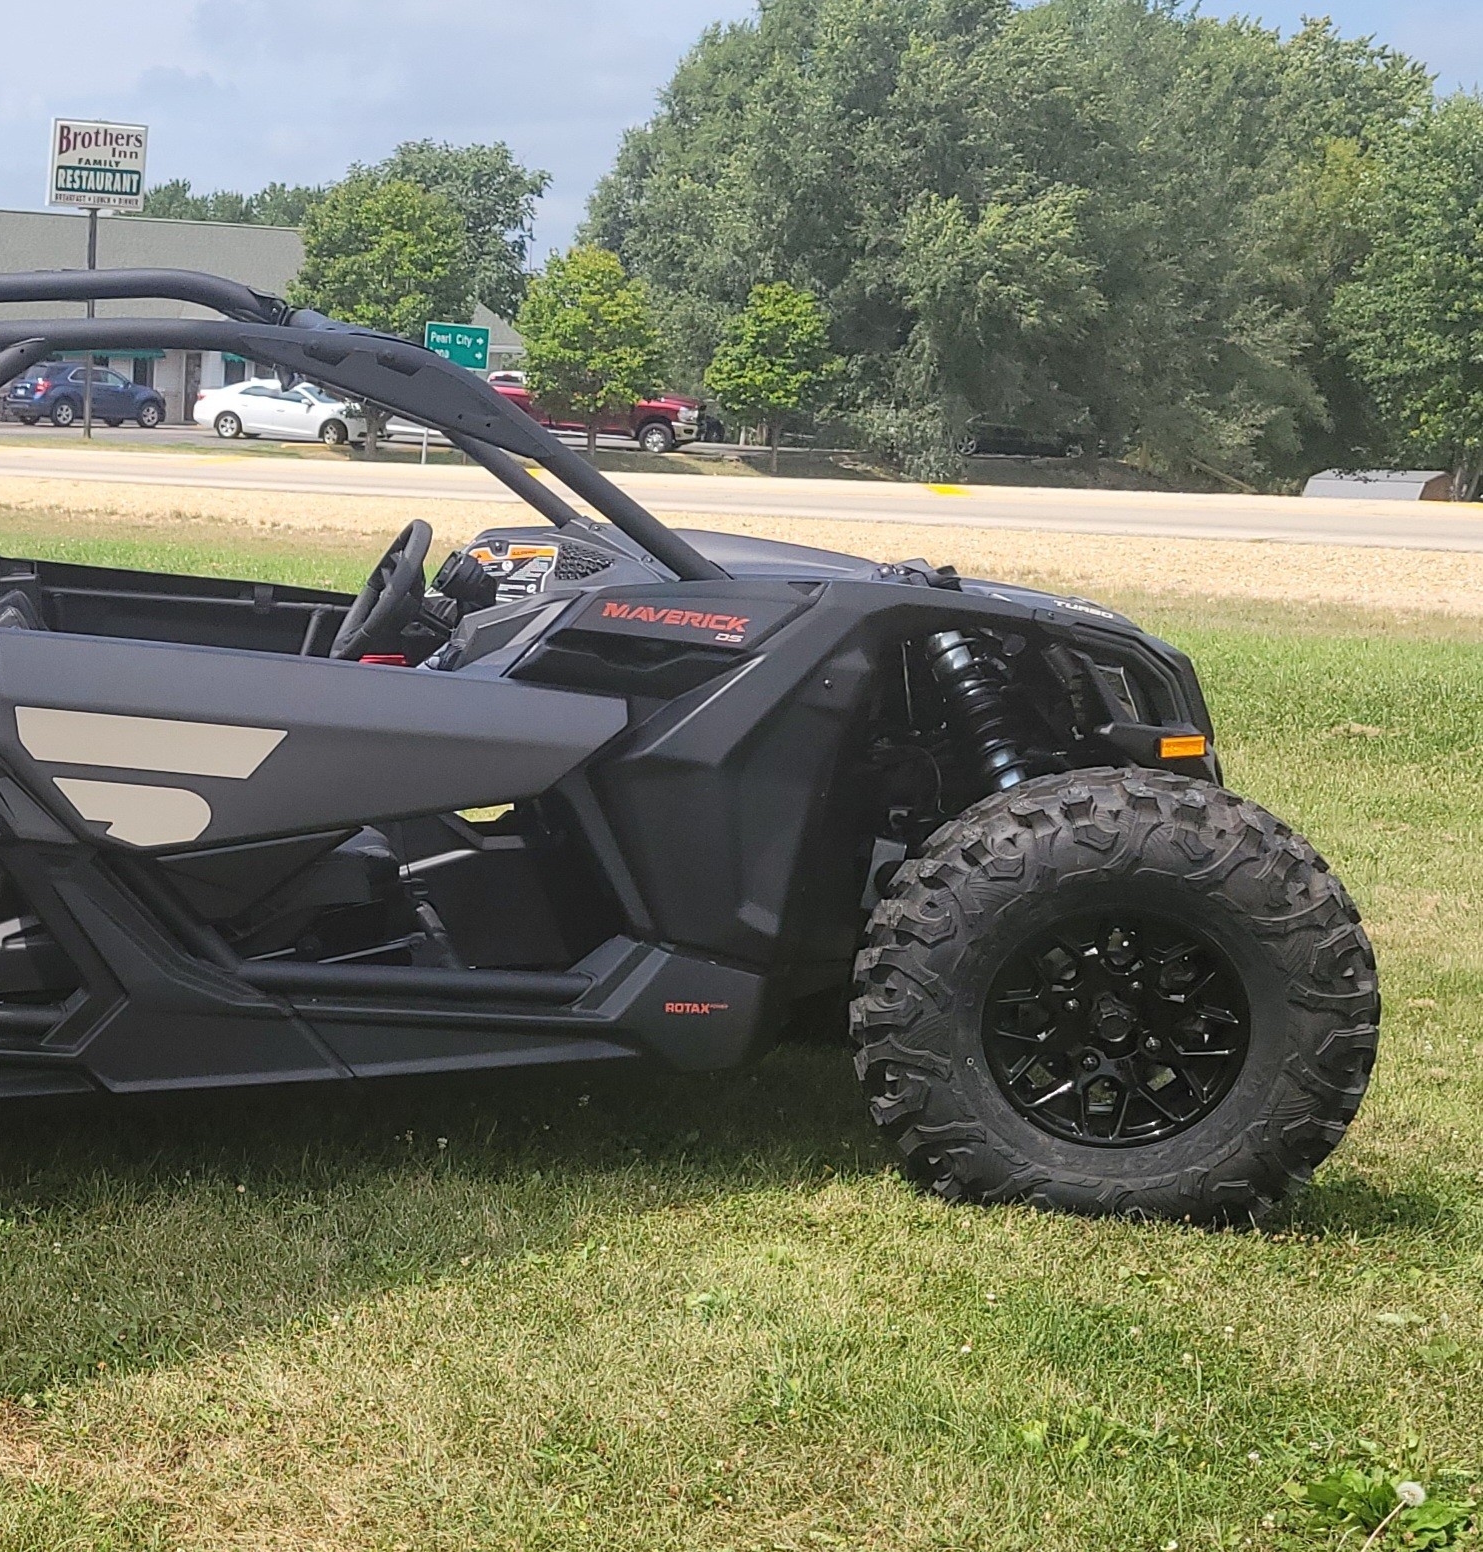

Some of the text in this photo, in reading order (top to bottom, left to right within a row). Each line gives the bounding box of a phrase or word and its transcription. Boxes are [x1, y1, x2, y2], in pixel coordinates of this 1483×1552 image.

[58, 125, 143, 155] Brothers
[111, 147, 139, 160] Inn
[77, 157, 121, 168] FAMILY
[57, 168, 139, 194] RESTAURANT
[55, 193, 139, 206] BREAKFAST LUNCH DINNER
[430, 331, 473, 348] Pearl City
[601, 601, 750, 633] MAVERICK
[1053, 600, 1114, 619] TURBO
[714, 632, 744, 643] DS
[665, 1002, 710, 1014] ROTAX
